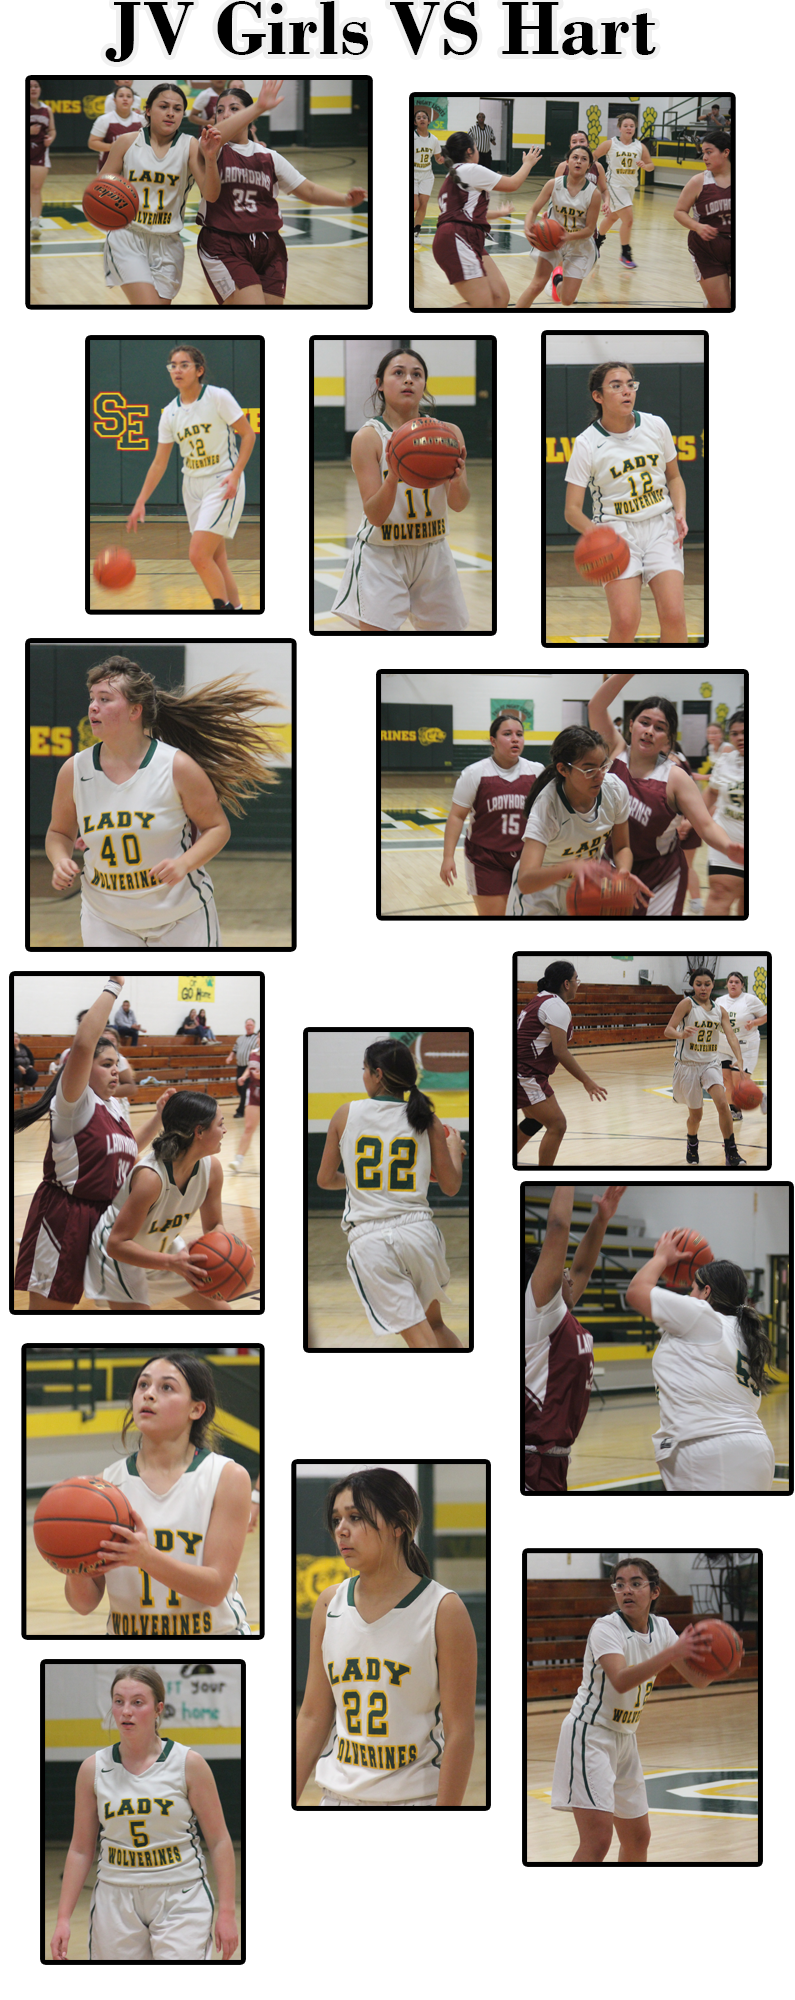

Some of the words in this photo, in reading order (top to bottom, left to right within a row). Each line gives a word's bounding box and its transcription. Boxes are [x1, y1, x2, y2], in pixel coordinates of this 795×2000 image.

[420, 153, 430, 163] 12
[621, 157, 633, 168] 40
[129, 169, 180, 187] LADY
[143, 187, 165, 210] 11
[232, 188, 258, 213] 25
[555, 205, 585, 217] LADY
[563, 214, 577, 228] 11
[93, 391, 150, 451] SE
[176, 423, 213, 442] LADY
[188, 438, 207, 458] 12
[609, 453, 660, 479] LADY
[627, 471, 654, 497] 12
[405, 488, 432, 519] 11
[614, 488, 666, 516] WOLVERINES
[381, 517, 446, 541] WOLVERINES
[487, 794, 527, 812] LADYHOR
[83, 810, 156, 834] LADY
[501, 813, 521, 835] 15
[100, 832, 143, 868] 40
[694, 1020, 719, 1030] LADY
[697, 1029, 713, 1043] 22
[355, 1134, 418, 1192] 22
[153, 1528, 203, 1556] DY
[111, 1610, 212, 1635] WOLVERINES
[328, 1656, 412, 1687] LADY
[191, 1681, 227, 1695] your
[182, 1701, 220, 1720] home
[342, 1689, 389, 1737] 22
[337, 1738, 418, 1771] OLVERINES
[104, 1797, 175, 1821] LADY
[129, 1819, 150, 1849] 5
[108, 1845, 182, 1868] WOLVERINES
